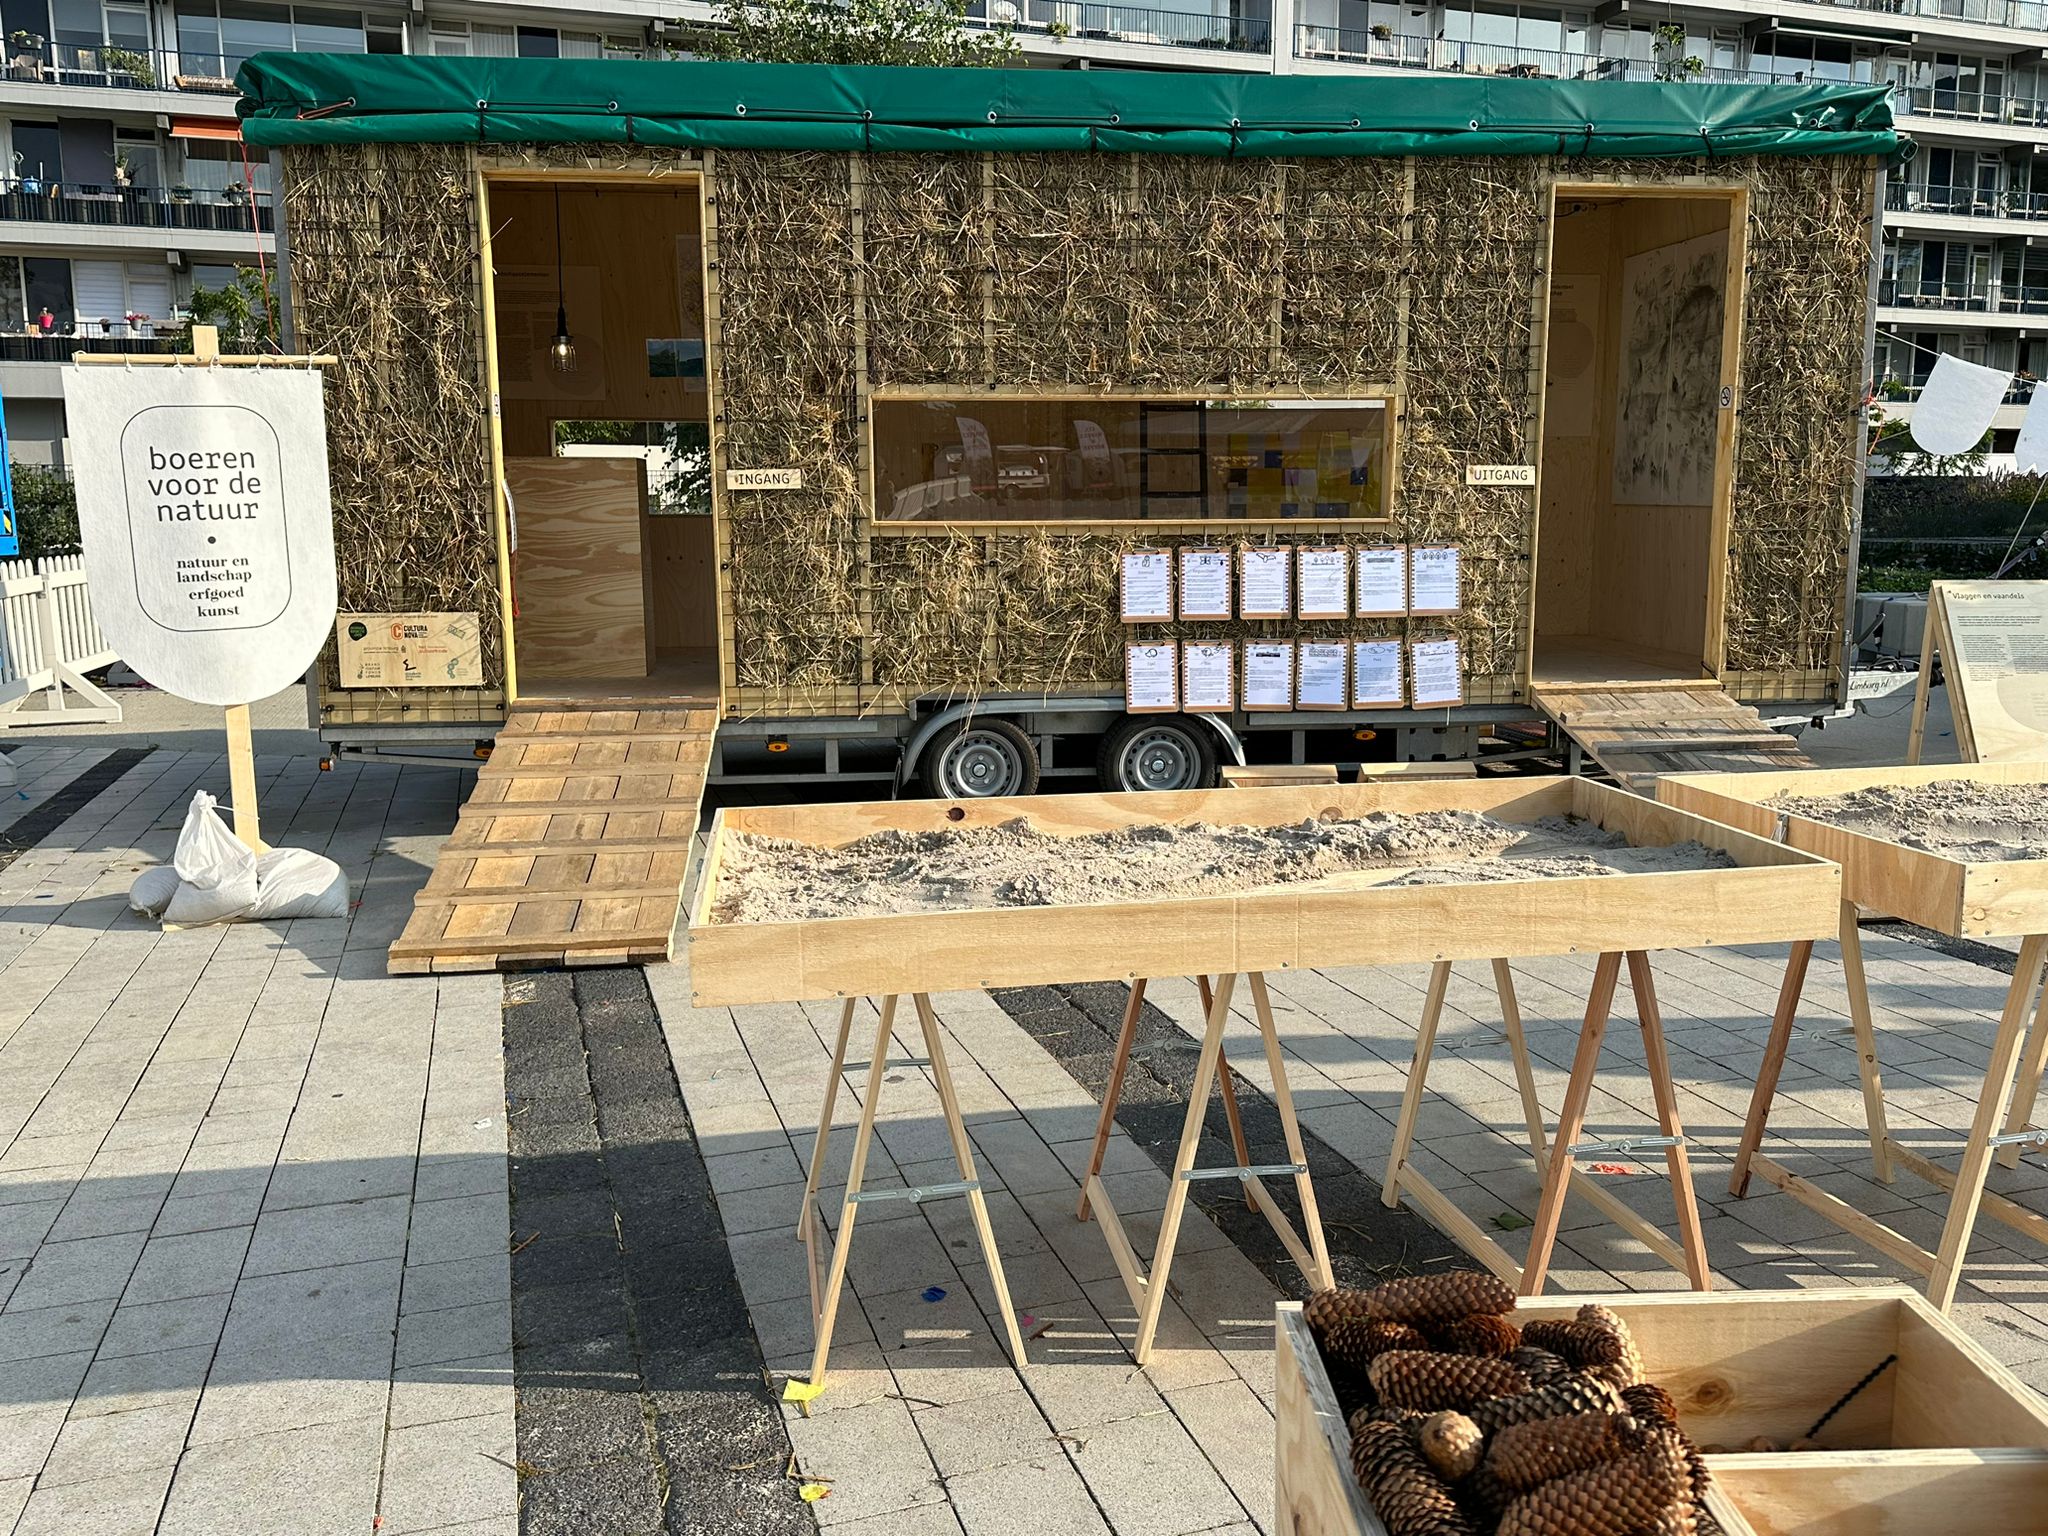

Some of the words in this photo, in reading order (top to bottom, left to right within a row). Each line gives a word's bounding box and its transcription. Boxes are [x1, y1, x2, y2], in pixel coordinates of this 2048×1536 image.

[149, 446, 255, 470] boeren
[738, 473, 790, 485] INGANG
[1474, 469, 1528, 481] UITGANG
[147, 478, 219, 496] voor
[229, 470, 262, 495] de
[157, 499, 259, 522] natuur
[176, 558, 228, 569] natuur
[232, 557, 249, 567] en
[176, 569, 252, 583] landschap
[188, 586, 244, 602] erfgoed
[1951, 592, 1982, 600] Vlaggen
[197, 605, 241, 617] kunst
